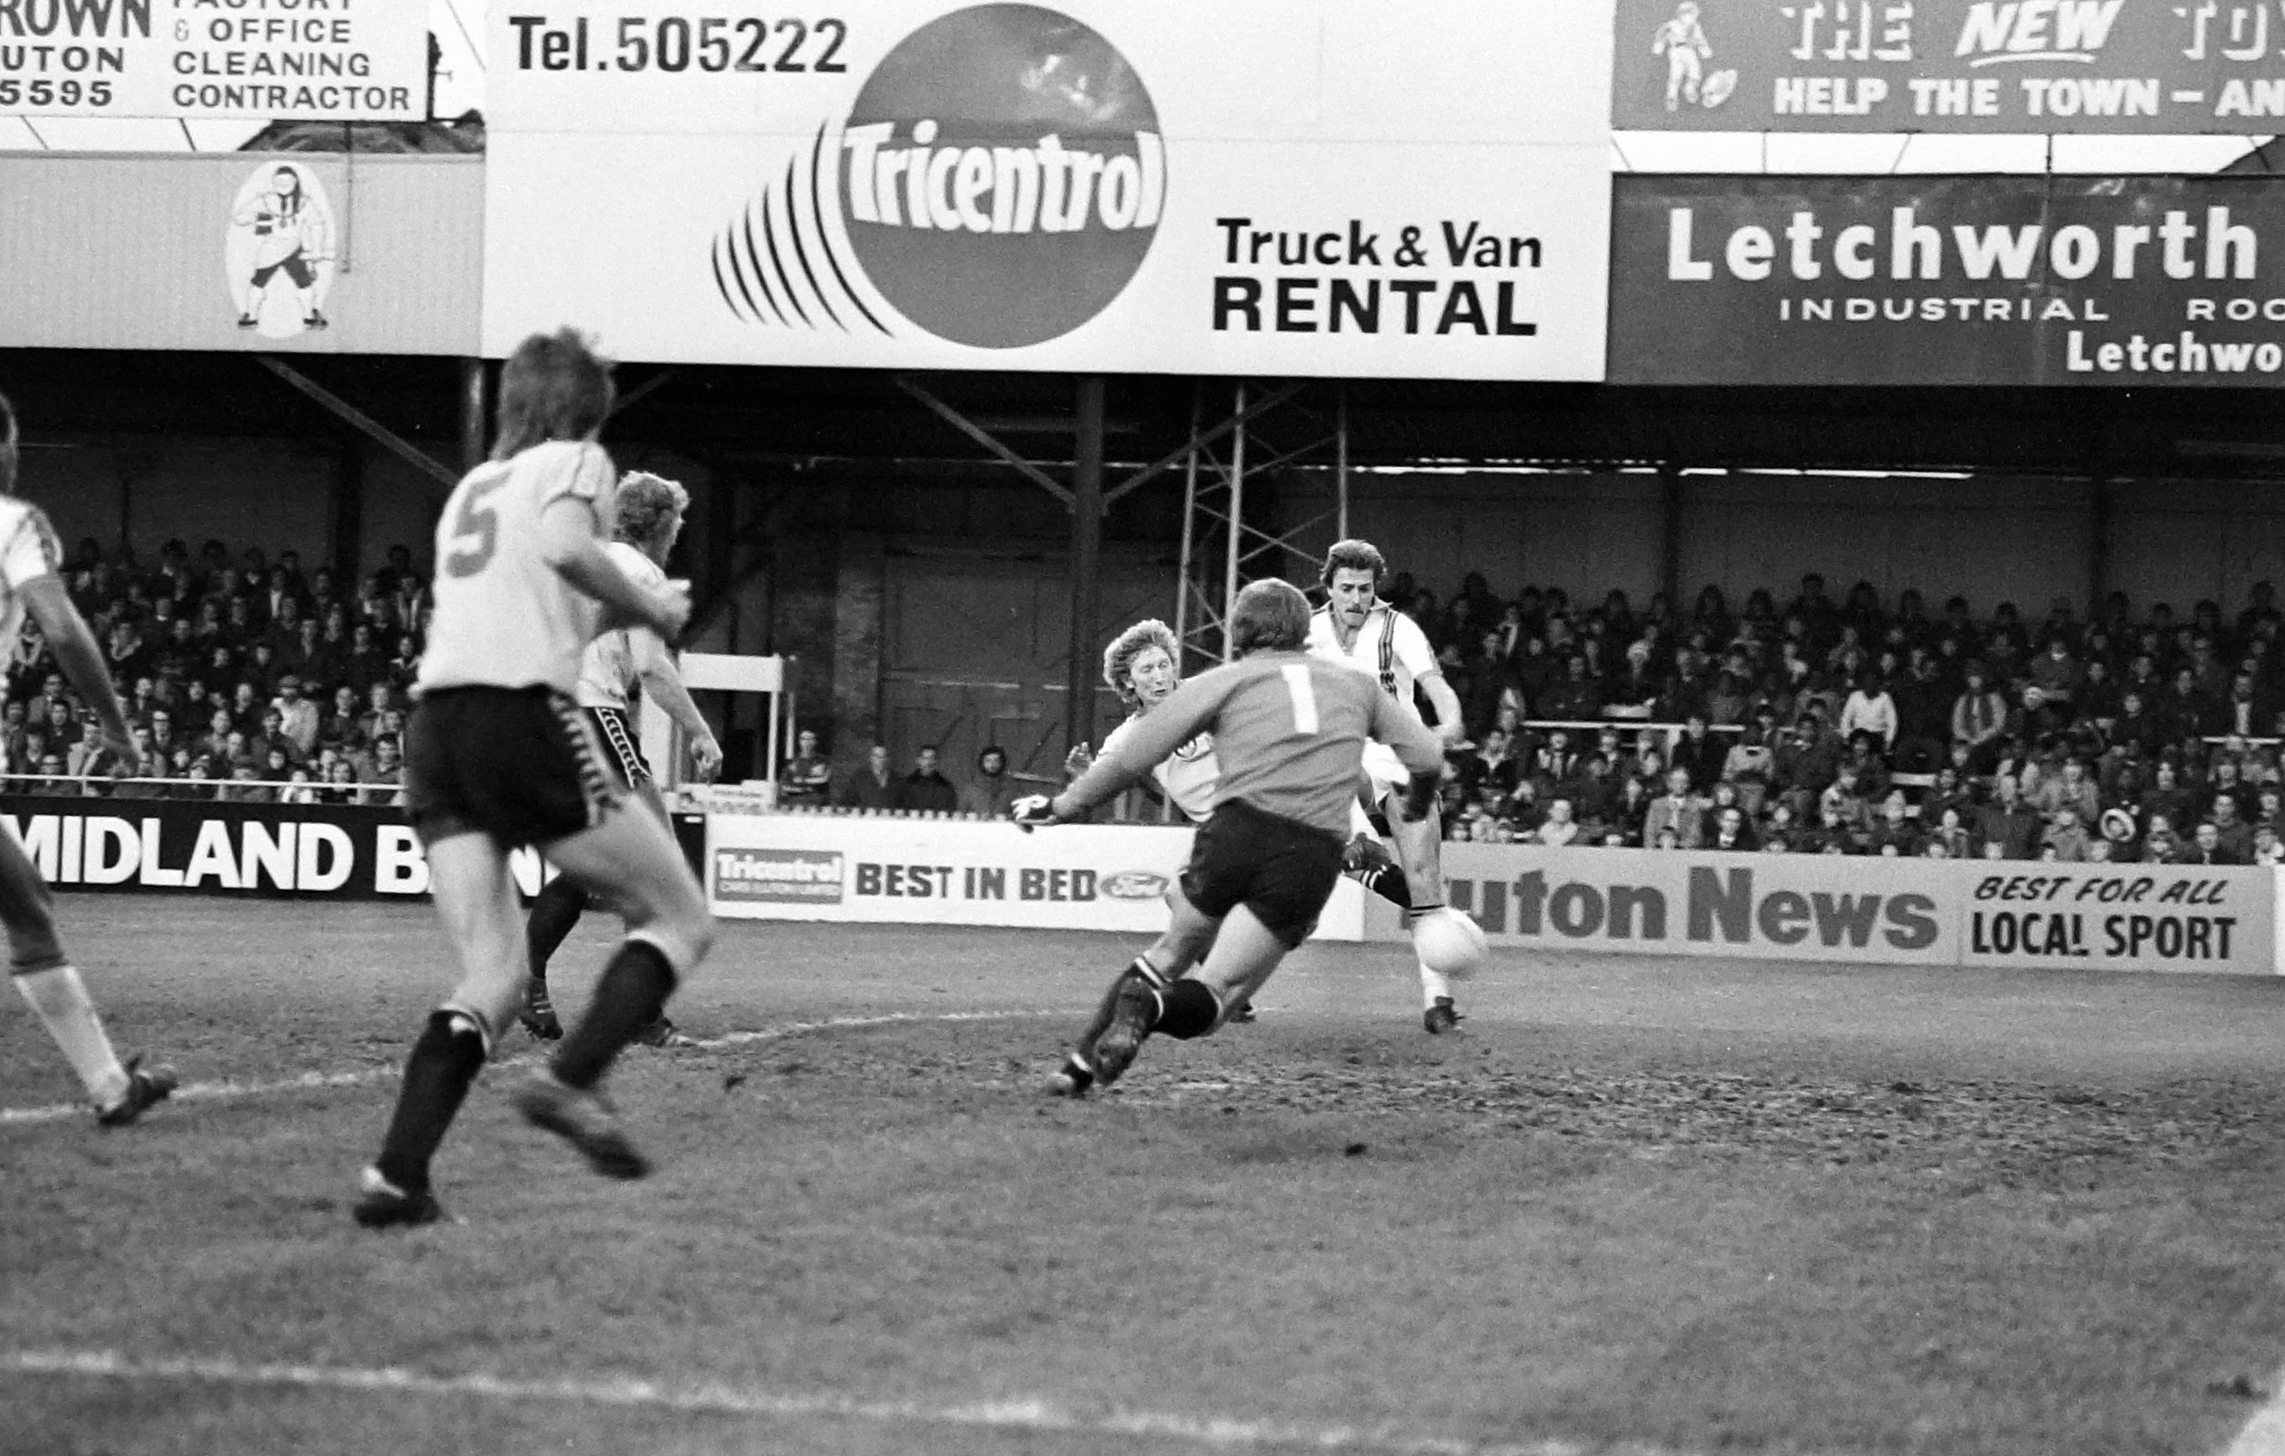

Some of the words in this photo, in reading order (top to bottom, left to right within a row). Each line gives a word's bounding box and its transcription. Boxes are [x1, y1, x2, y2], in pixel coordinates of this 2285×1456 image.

[208, 17, 351, 43] OFFICE
[1781, 0, 1914, 61] THE
[1954, 0, 2124, 56] NEW
[2172, 0, 2285, 61] TO
[1, 45, 124, 73] UTON
[173, 50, 370, 77] CLEANING
[0, 79, 112, 107] 5595
[172, 83, 409, 110] CONTRACTOR
[1773, 77, 1889, 115] HELP
[1907, 78, 2000, 116] THE
[2020, 78, 2160, 116] TOWN
[2213, 78, 2285, 117] AN
[842, 119, 1163, 233] Tricentrol
[1216, 217, 1382, 266] Truck
[1393, 225, 1428, 268] &
[1441, 220, 1542, 268] Van
[1668, 206, 2257, 281] Letchworth
[1212, 276, 1537, 337] RENTAL
[1780, 298, 2109, 321] INDUSTRIAL
[2067, 330, 2284, 372] Letchwo
[446, 469, 514, 578] 5
[1281, 664, 1319, 734] 1
[856, 862, 954, 898] BEST
[964, 867, 1006, 900] IN
[1019, 868, 1098, 902] BED
[1974, 876, 2072, 901] BEST
[2075, 877, 2155, 902] FOR
[2159, 879, 2229, 904] ALL
[1402, 869, 1668, 940] uton
[1687, 867, 1940, 949] News
[1972, 911, 2090, 957] LOCAL
[2104, 914, 2237, 959] SPORT
